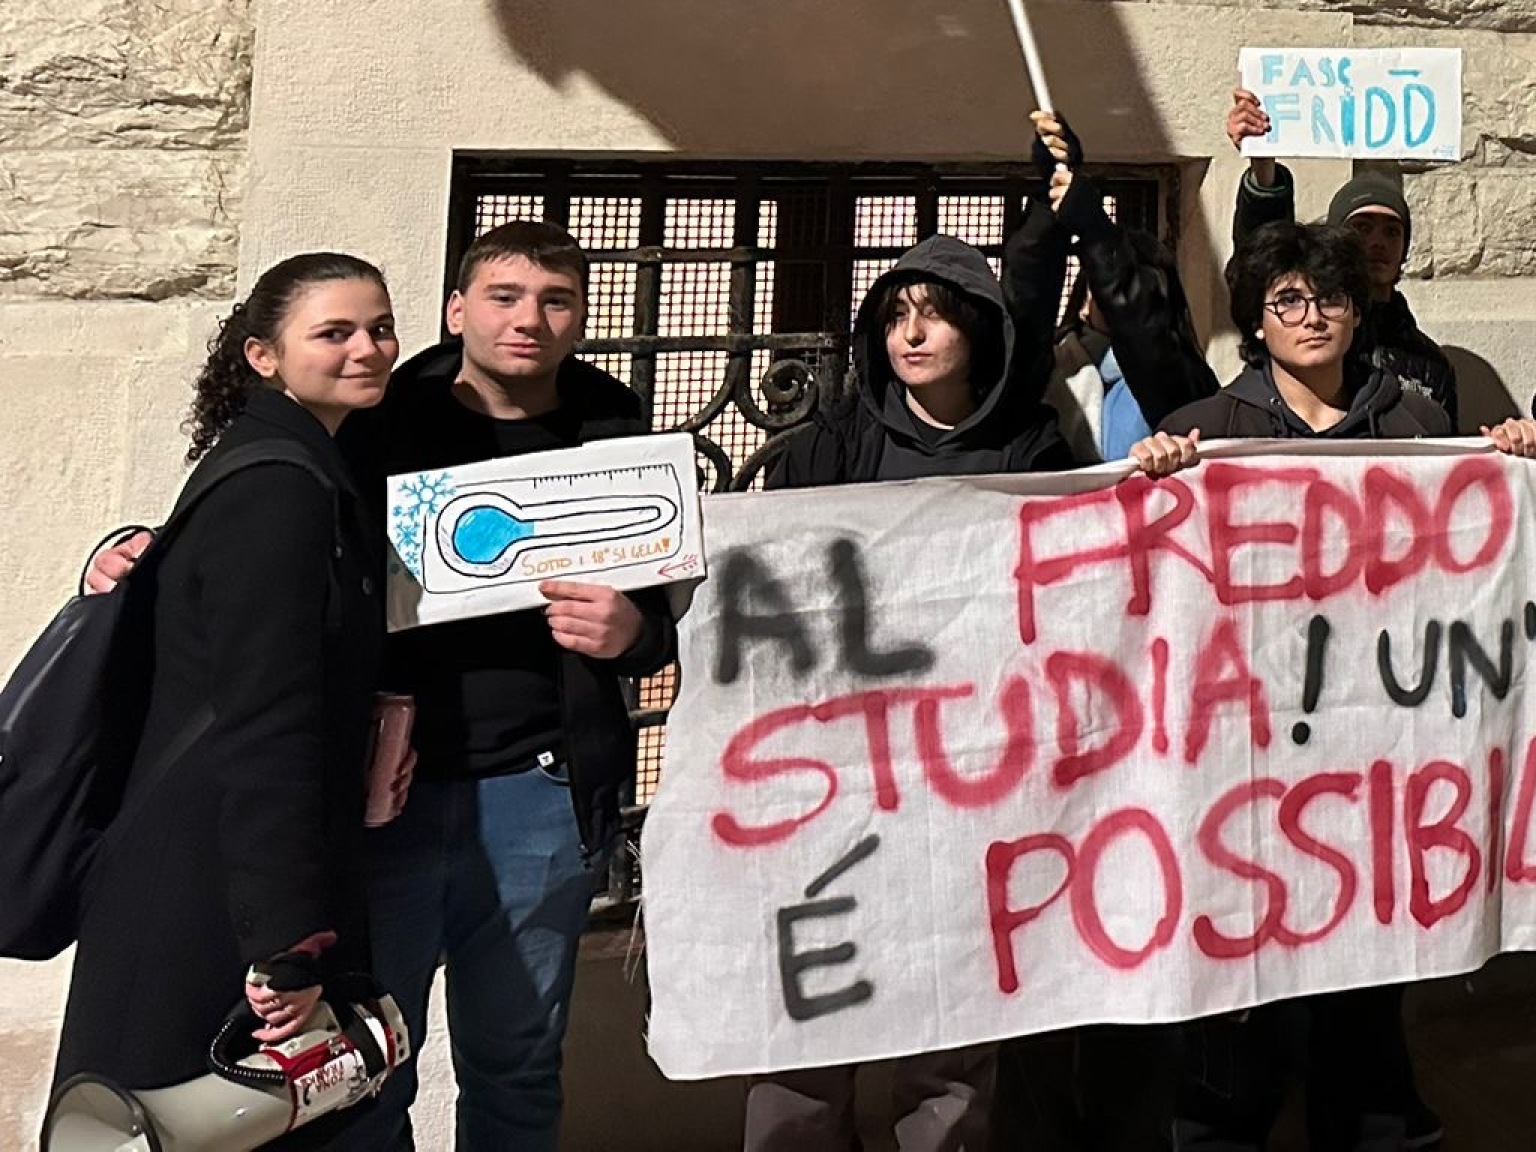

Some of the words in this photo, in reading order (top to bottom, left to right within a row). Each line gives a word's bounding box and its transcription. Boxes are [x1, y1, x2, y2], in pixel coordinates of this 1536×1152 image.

[1264, 83, 1436, 149] FRIDD
[711, 538, 938, 685] AL
[1013, 455, 1517, 645] FREDDO
